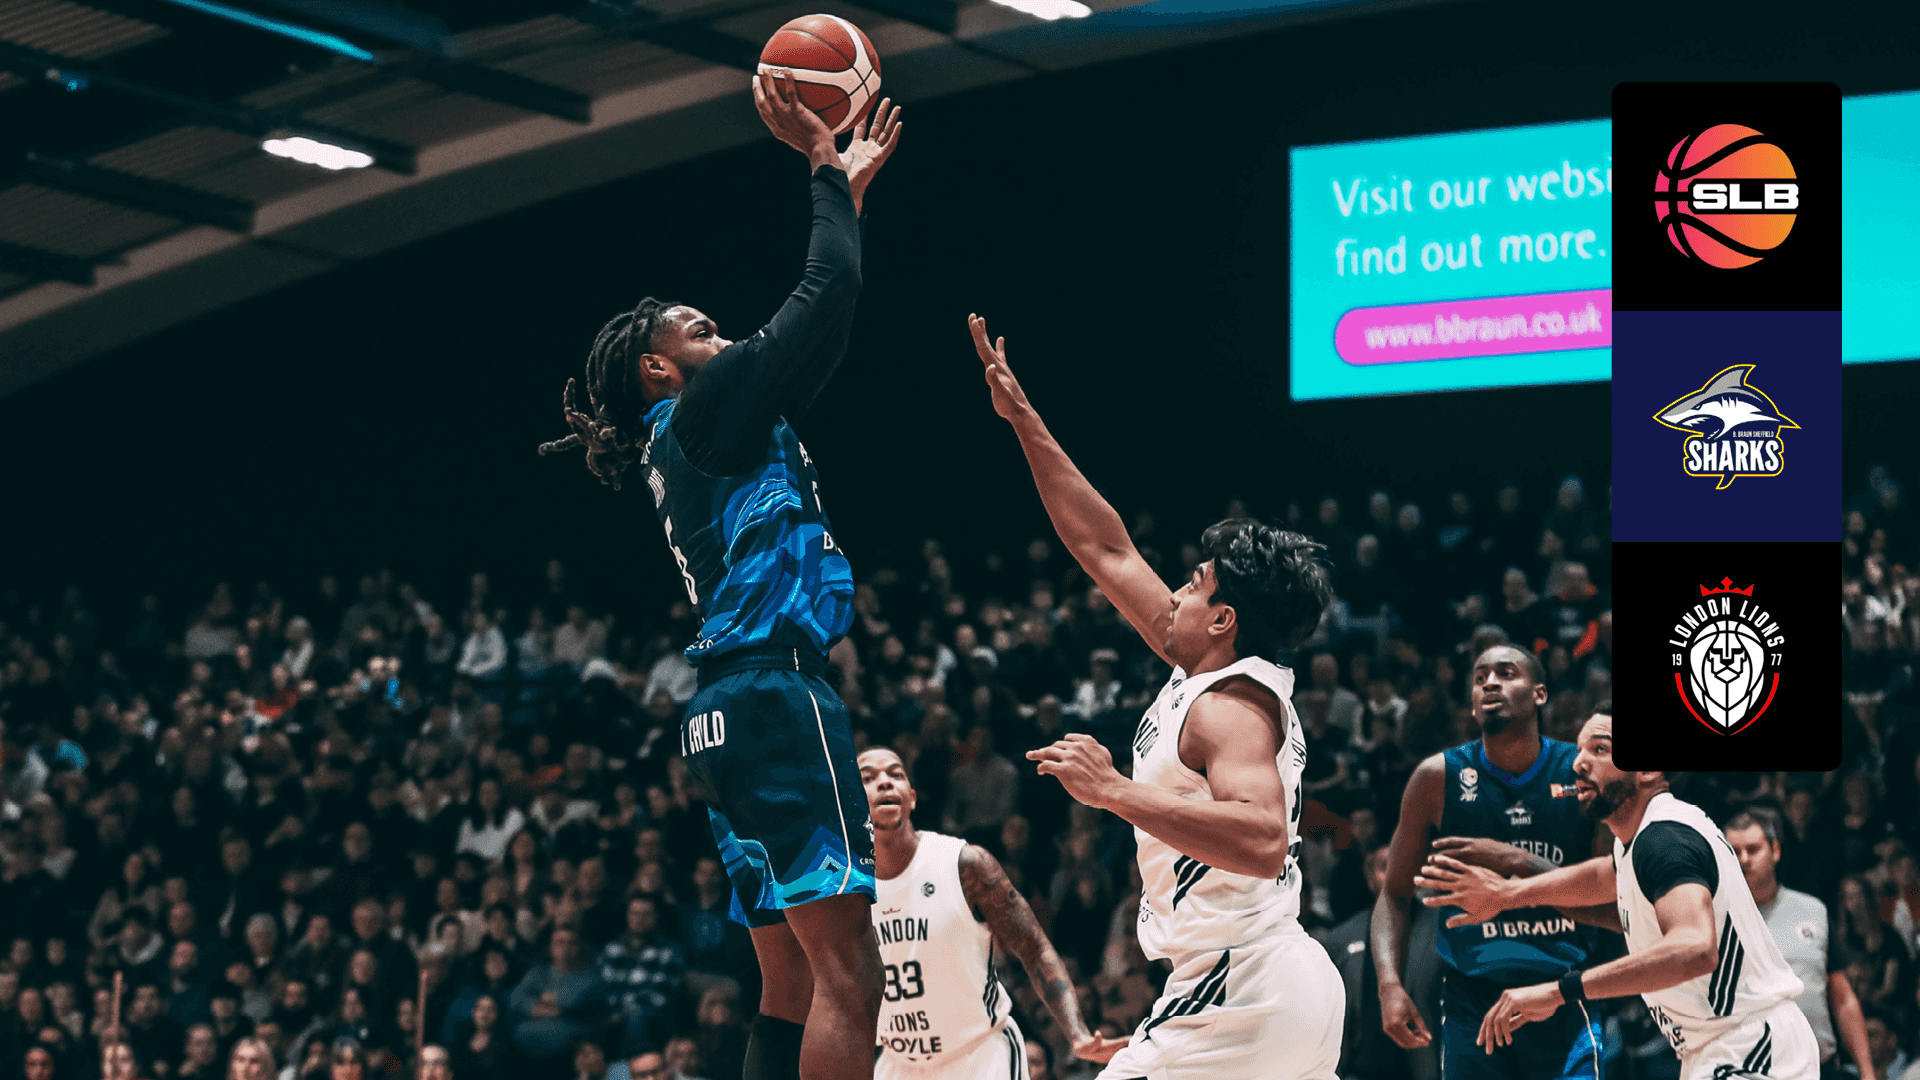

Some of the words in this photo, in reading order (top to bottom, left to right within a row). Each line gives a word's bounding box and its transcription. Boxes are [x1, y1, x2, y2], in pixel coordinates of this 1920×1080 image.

[1332, 175, 1414, 217] Visit
[1429, 178, 1491, 210] our
[1335, 235, 1406, 277] find
[1421, 233, 1483, 272] out
[1500, 229, 1606, 264] more.
[1365, 301, 1603, 350] www.bbraun.co.uk
[1503, 917, 1576, 938] BRAUN
[884, 960, 925, 1003] 33
